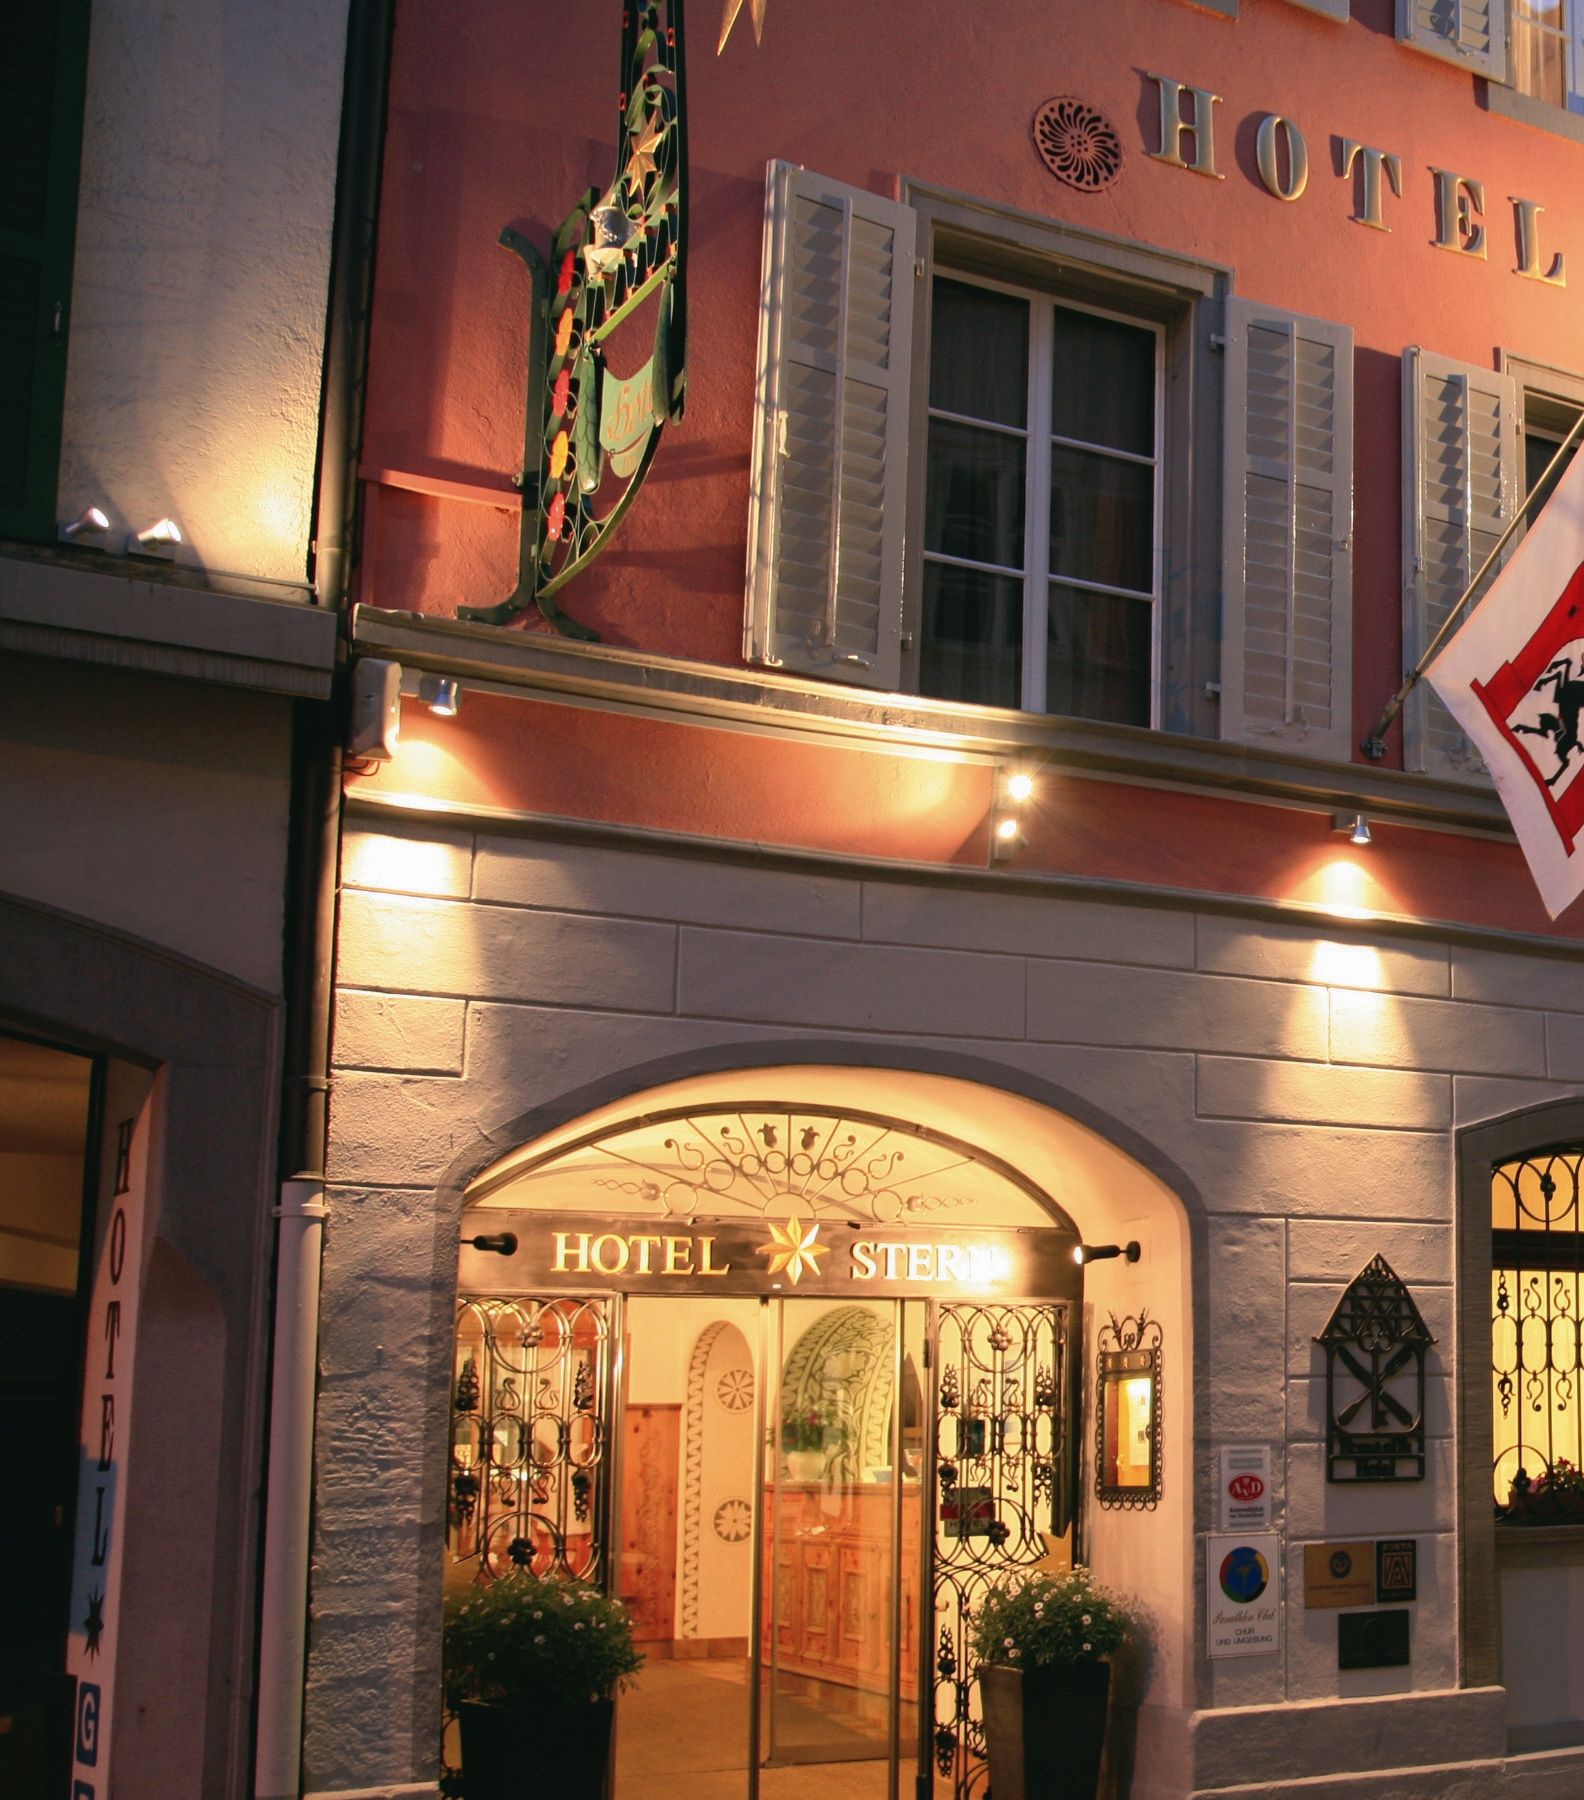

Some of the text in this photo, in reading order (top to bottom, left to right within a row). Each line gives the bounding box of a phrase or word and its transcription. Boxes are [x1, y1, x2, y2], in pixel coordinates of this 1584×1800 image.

[1144, 72, 1567, 287] HOTEL
[91, 1117, 134, 1567] HOTEL
[551, 1232, 729, 1276] HOTEL
